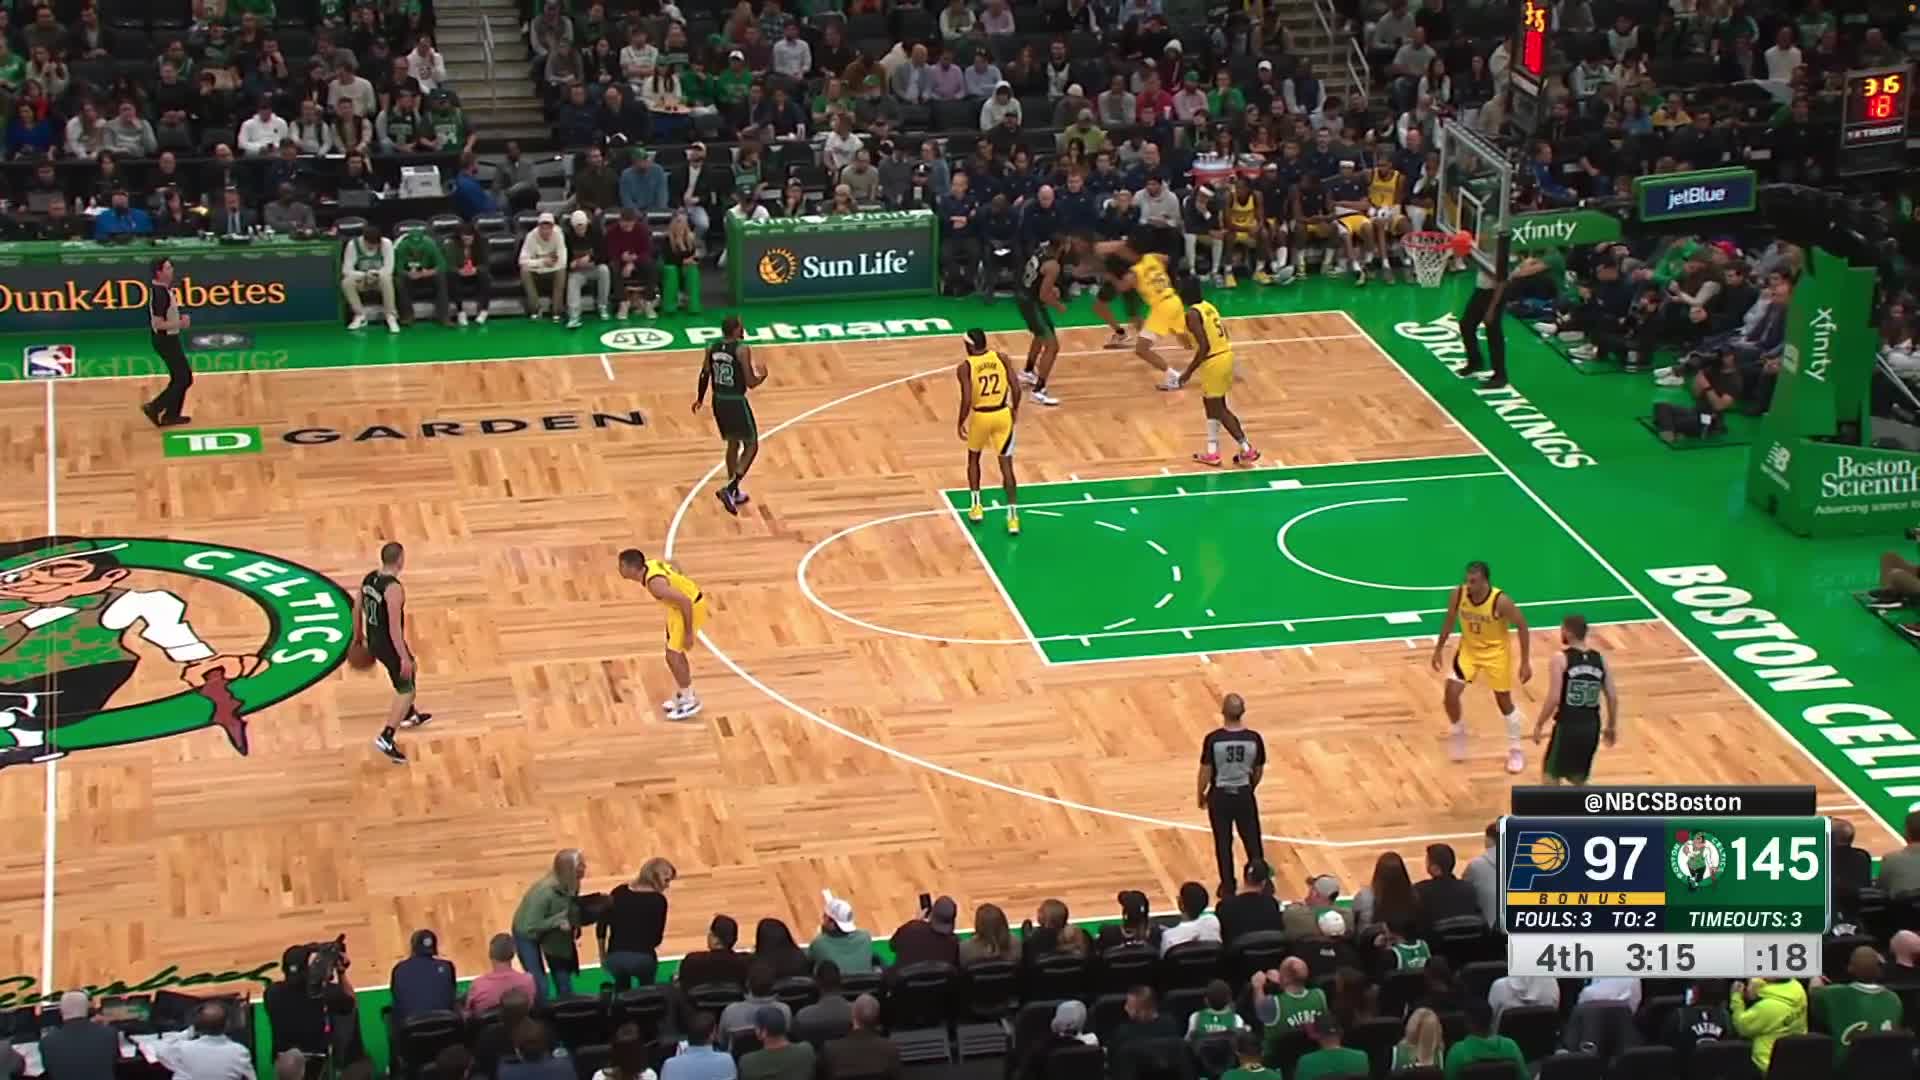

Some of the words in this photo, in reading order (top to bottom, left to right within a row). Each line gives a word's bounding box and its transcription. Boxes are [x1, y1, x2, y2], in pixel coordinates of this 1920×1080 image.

[1667, 185, 1726, 210] jetBlue
[1511, 220, 1577, 245] xfinity
[802, 255, 854, 279] Sun
[859, 250, 907, 276] Life
[0, 276, 286, 314] unk4Dabetes
[1804, 307, 1837, 382] xfinity
[713, 363, 735, 387] 12
[978, 374, 1000, 396] 22
[1394, 311, 1599, 469] DRATKINGS
[170, 430, 253, 452] TD
[282, 410, 646, 446] GARDEN
[1837, 455, 1912, 479] Boston
[183, 550, 343, 664] CELTICS
[1645, 564, 1855, 692] BOSTON
